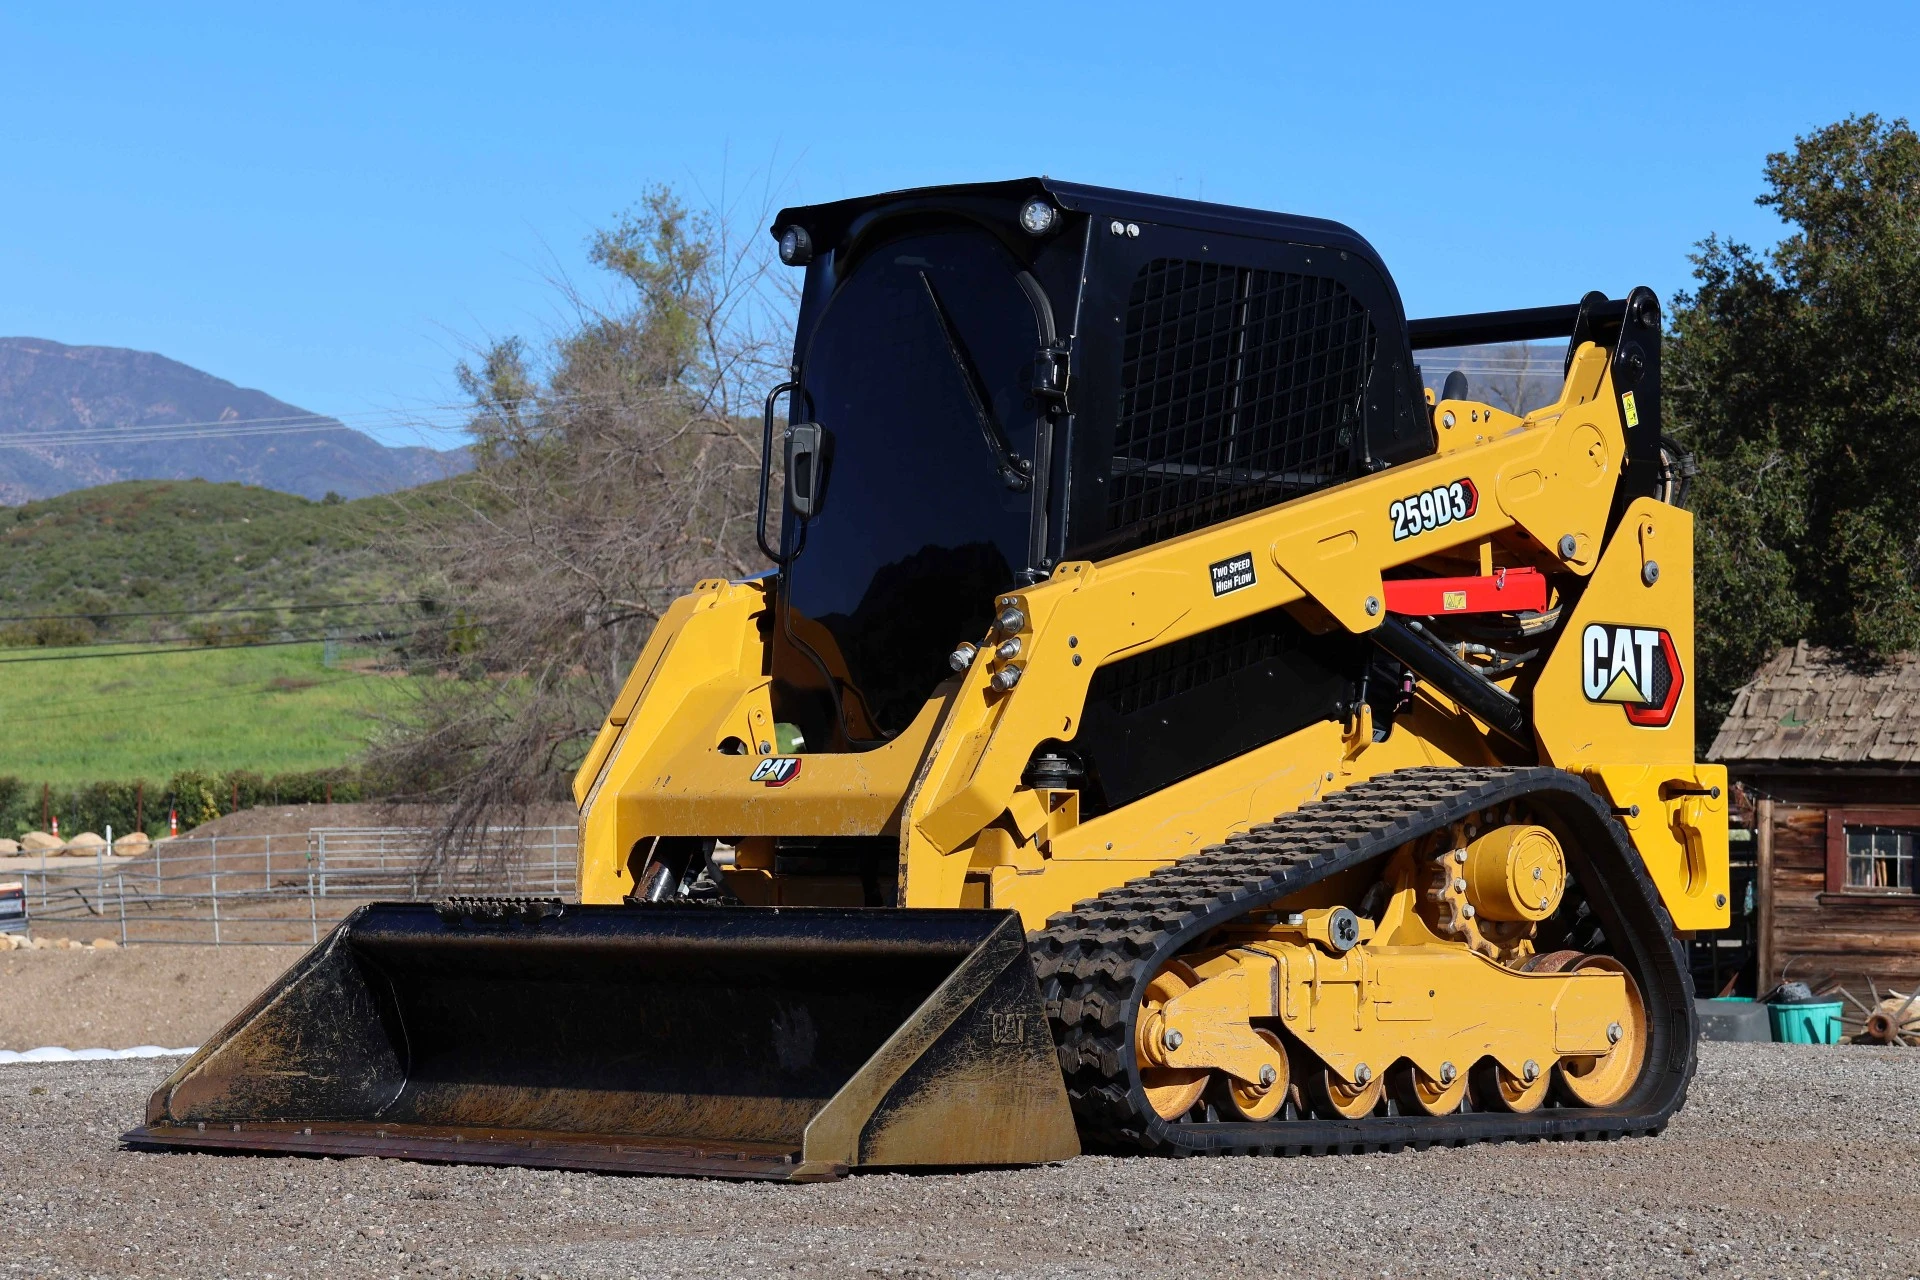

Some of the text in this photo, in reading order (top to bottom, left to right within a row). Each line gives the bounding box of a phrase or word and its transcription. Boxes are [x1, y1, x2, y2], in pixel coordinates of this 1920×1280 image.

[1390, 481, 1467, 540] 259D3
[1212, 558, 1250, 579] TWO SPEED
[1215, 572, 1252, 593] HIGH FLOW
[1583, 624, 1659, 704] CAT
[751, 758, 798, 781] CAT
